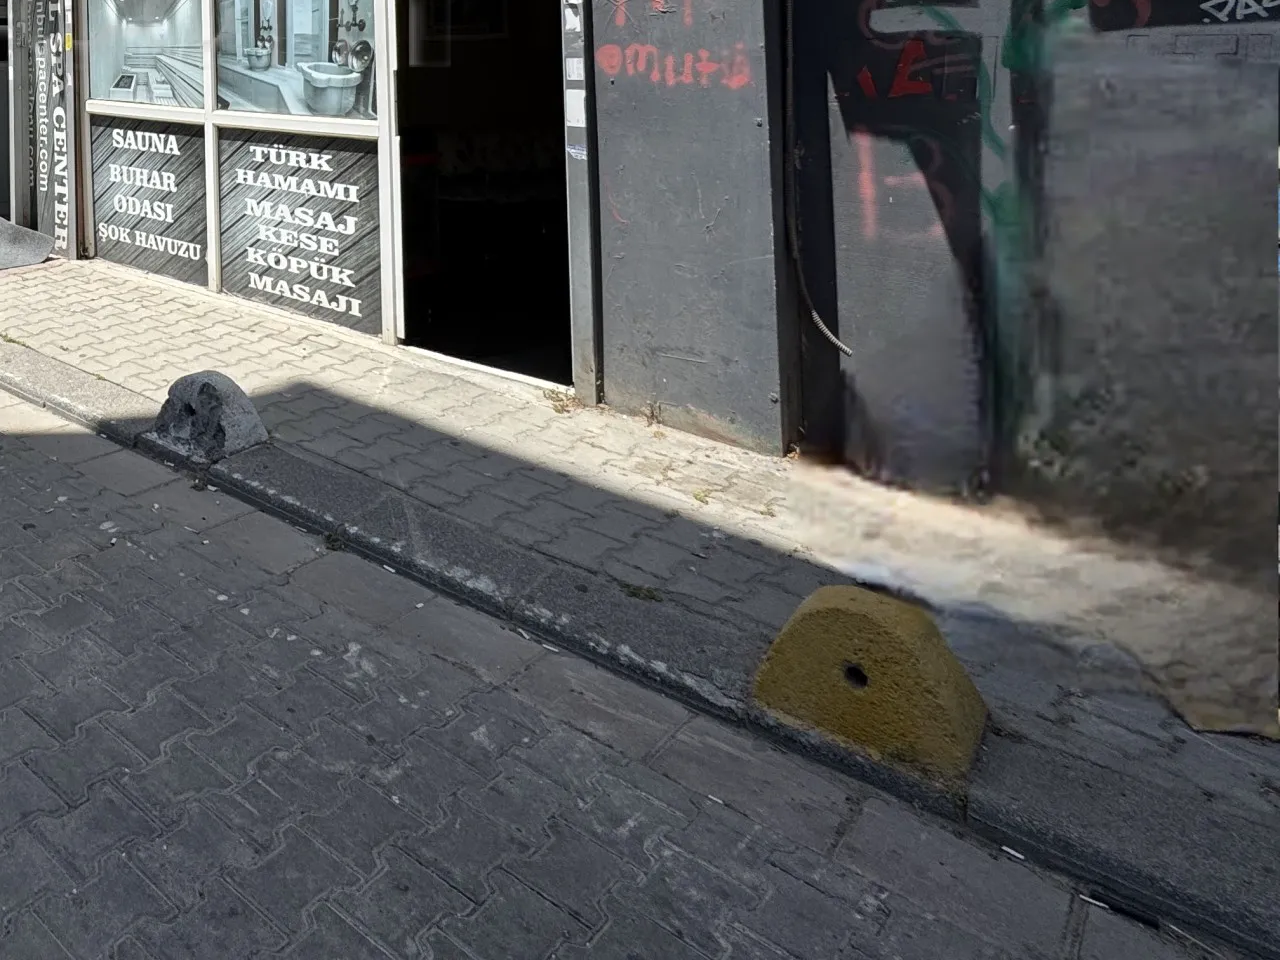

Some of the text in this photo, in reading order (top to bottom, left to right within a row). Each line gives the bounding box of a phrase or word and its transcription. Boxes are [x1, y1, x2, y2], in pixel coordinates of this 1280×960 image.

[50, 32, 64, 98] SPA
[112, 128, 181, 156] SAUNA
[249, 144, 333, 172] TÜRK
[52, 106, 69, 252] CENTER
[109, 164, 177, 192] BUHAR
[235, 169, 359, 203] HAMAMI
[113, 194, 174, 223] ODASI
[245, 198, 358, 235] MASAJ
[98, 222, 201, 261] ŞOK HAVUZU
[258, 224, 340, 257] KESE
[246, 246, 356, 288] KÖPÜK
[248, 272, 362, 318] MASAJI
